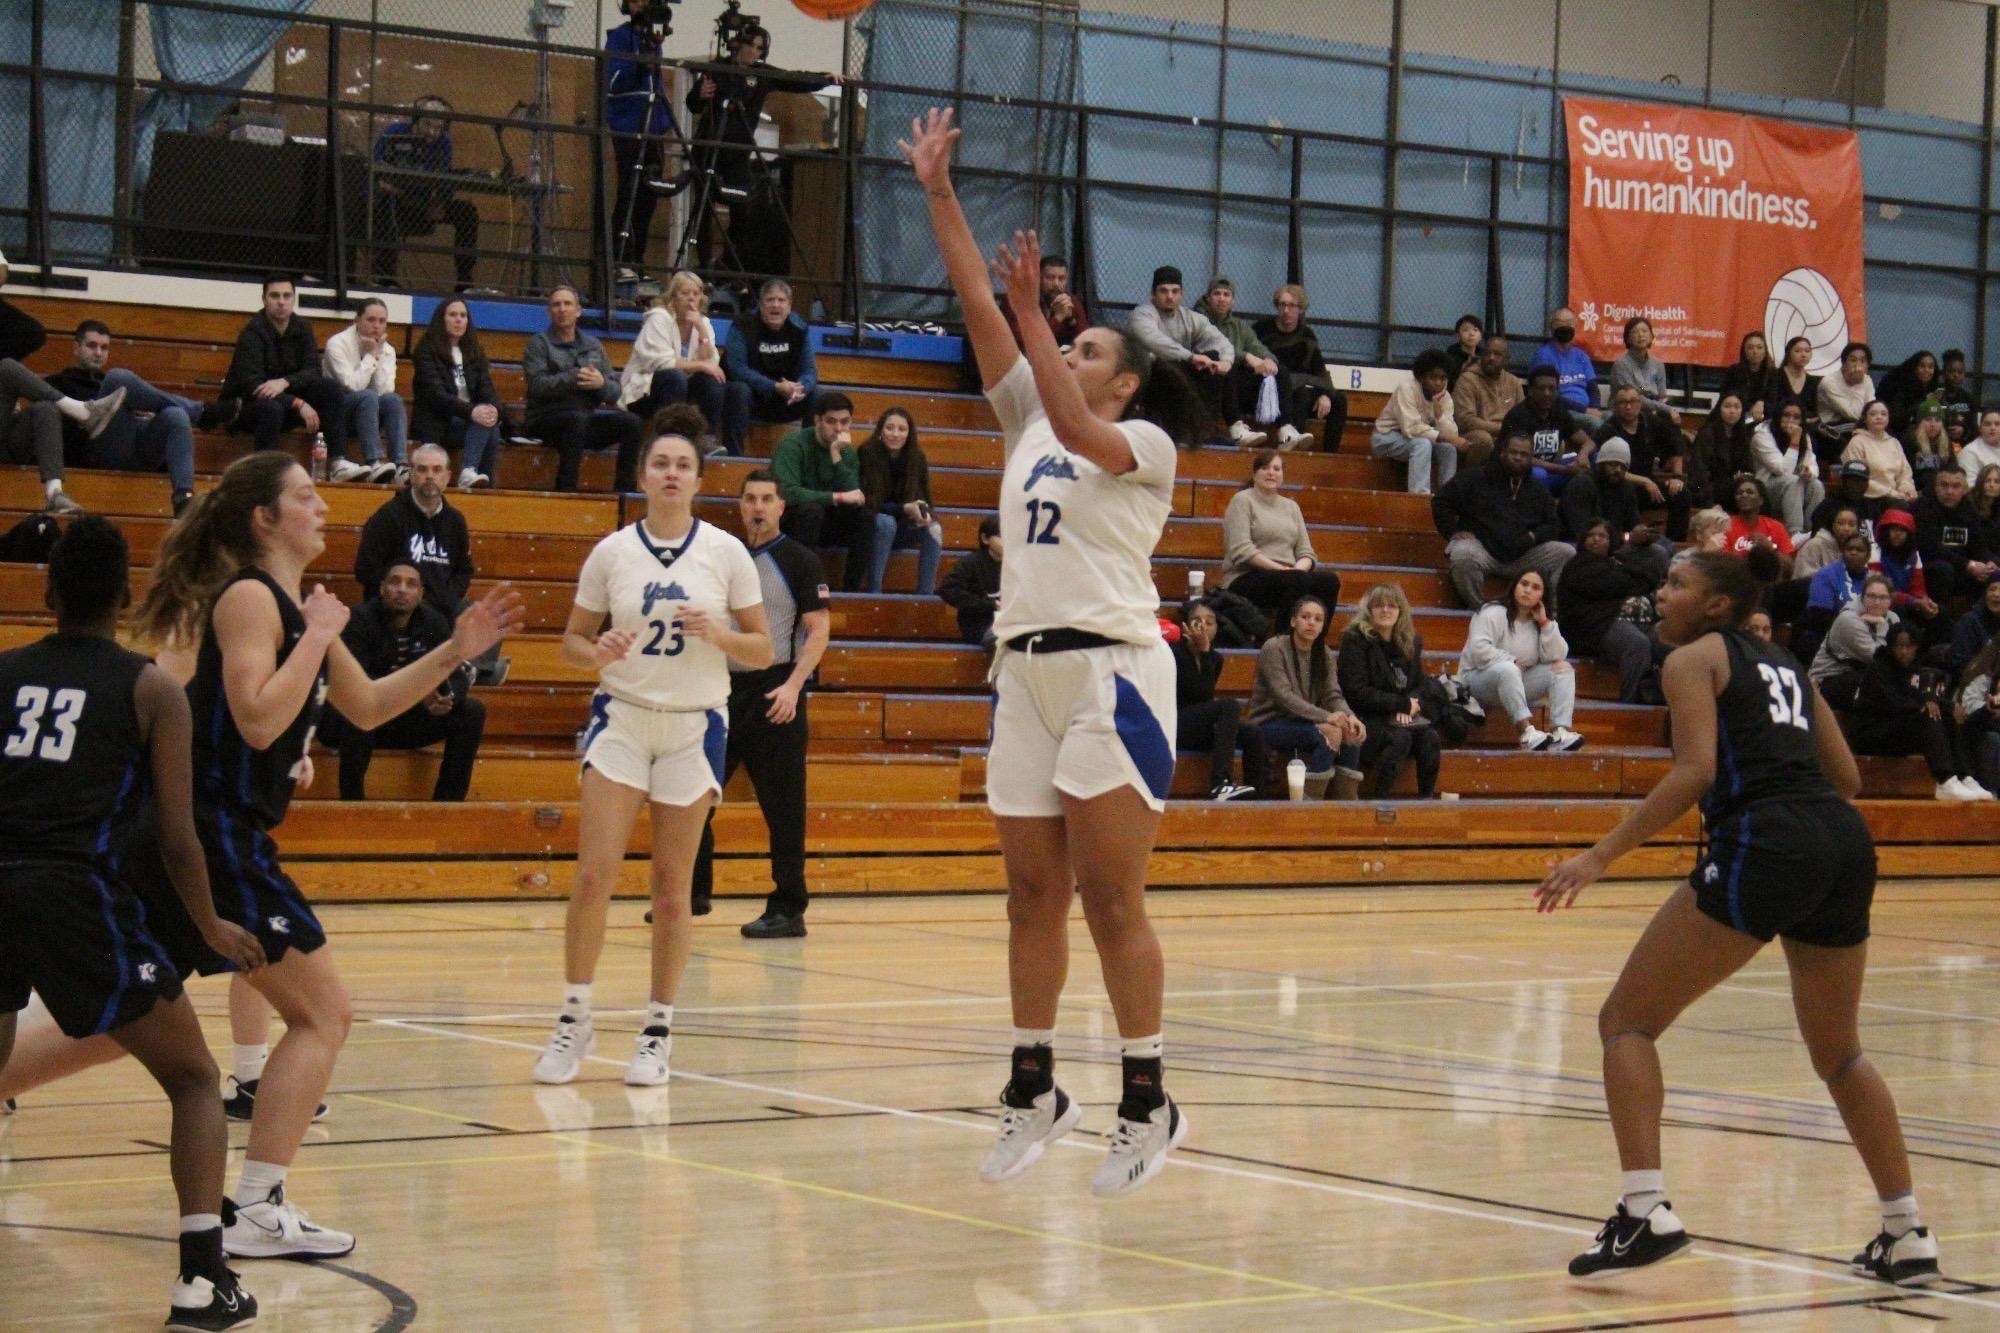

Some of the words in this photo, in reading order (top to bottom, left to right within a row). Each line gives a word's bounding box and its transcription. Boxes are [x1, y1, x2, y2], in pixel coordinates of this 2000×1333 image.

[1579, 115, 1693, 173] Serving
[1697, 136, 1734, 176] up
[1583, 166, 1817, 229] humankindness.
[1603, 303, 1642, 322] Dignity
[1644, 306, 1687, 320] Health
[1351, 368, 1362, 389] B
[1026, 498, 1061, 544] 12
[641, 619, 685, 656] 23
[1757, 662, 1809, 731] 32
[4, 685, 87, 762] 33
